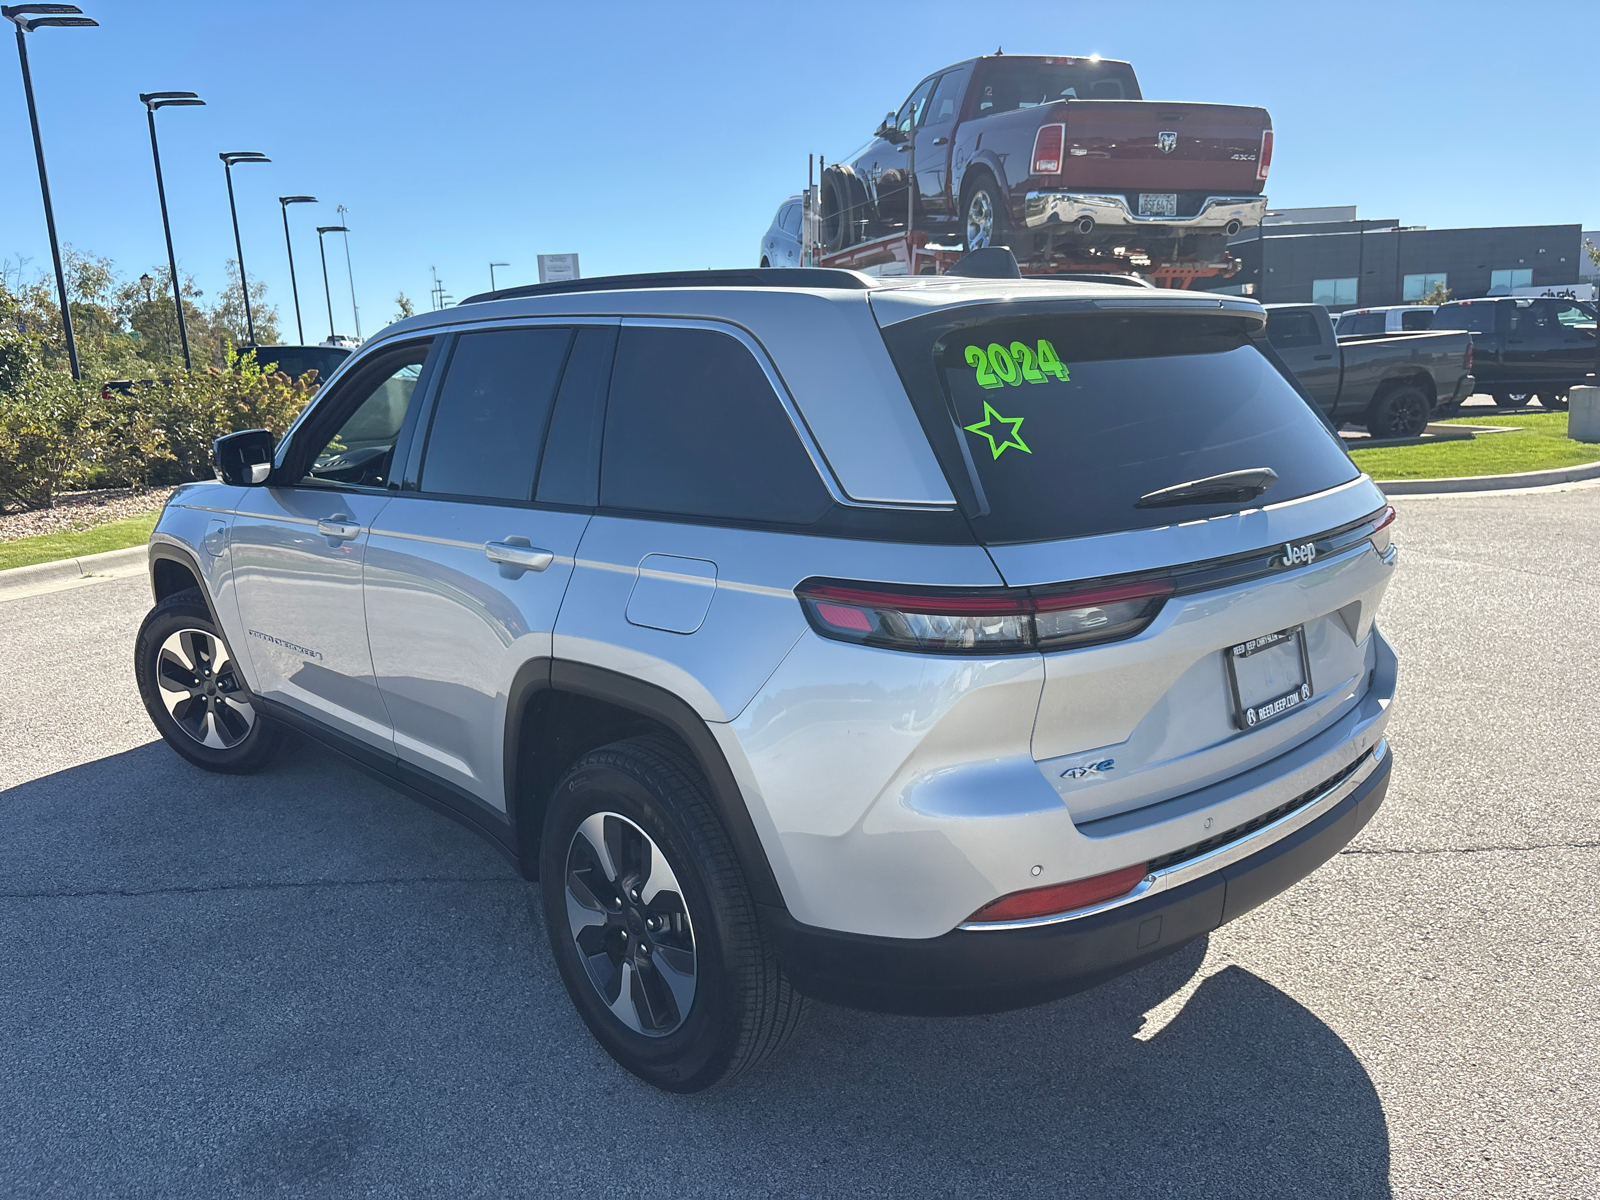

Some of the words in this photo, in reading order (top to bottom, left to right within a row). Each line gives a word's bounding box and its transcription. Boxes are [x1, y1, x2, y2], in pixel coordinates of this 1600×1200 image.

[964, 339, 1071, 390] 2024
[1282, 543, 1316, 566] Jeep
[1233, 645, 1245, 656] REED
[1246, 641, 1256, 650] JEEP
[1258, 692, 1300, 720] REEDJEEP.COM
